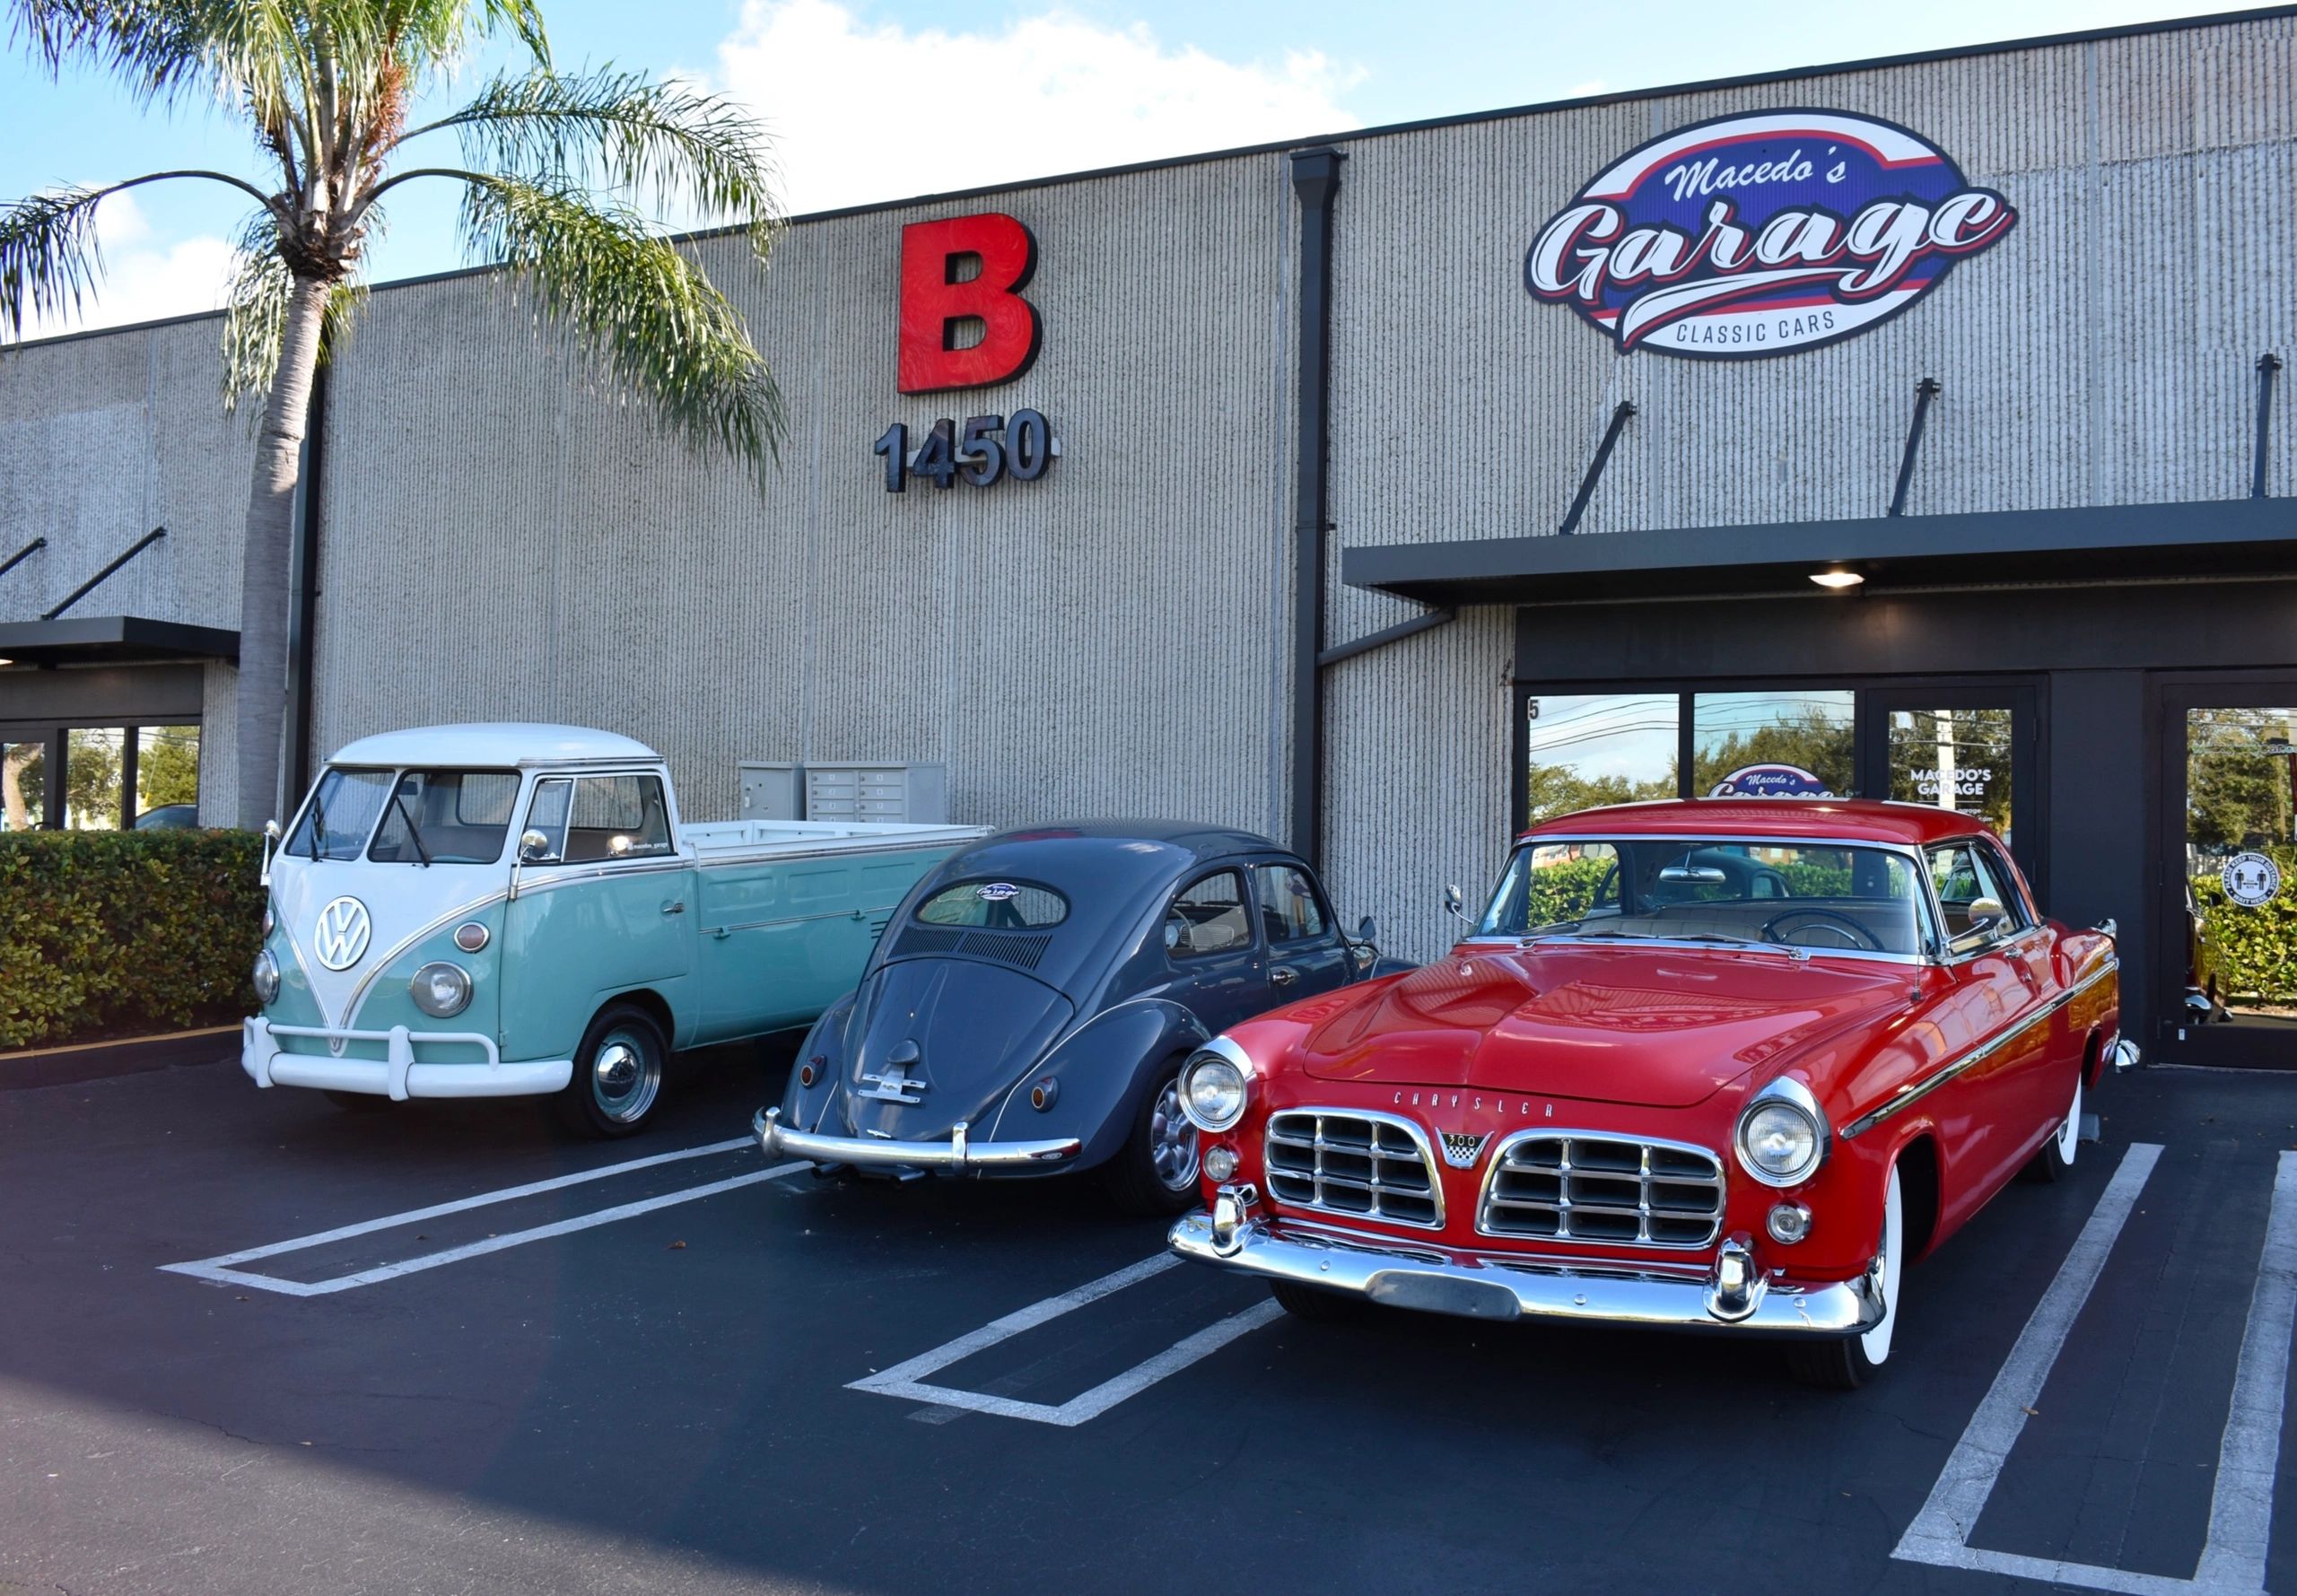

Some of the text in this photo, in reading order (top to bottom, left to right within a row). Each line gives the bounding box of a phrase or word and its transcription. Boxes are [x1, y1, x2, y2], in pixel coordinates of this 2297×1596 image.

[1664, 145, 1847, 201] Macedo's
[1531, 193, 2007, 302] Garage
[897, 213, 1041, 395] B
[1676, 310, 1835, 344] CLASSIC CARS
[875, 408, 1052, 493] 1450
[1529, 699, 1539, 720] 5
[1746, 773, 1795, 786] Macedo's
[1910, 769, 1992, 781] MACEDO'S
[1917, 783, 1984, 795] GARAGE
[318, 898, 369, 969] VW
[1394, 1092, 1552, 1117] CHRYSLER
[1449, 1134, 1476, 1147] 300
